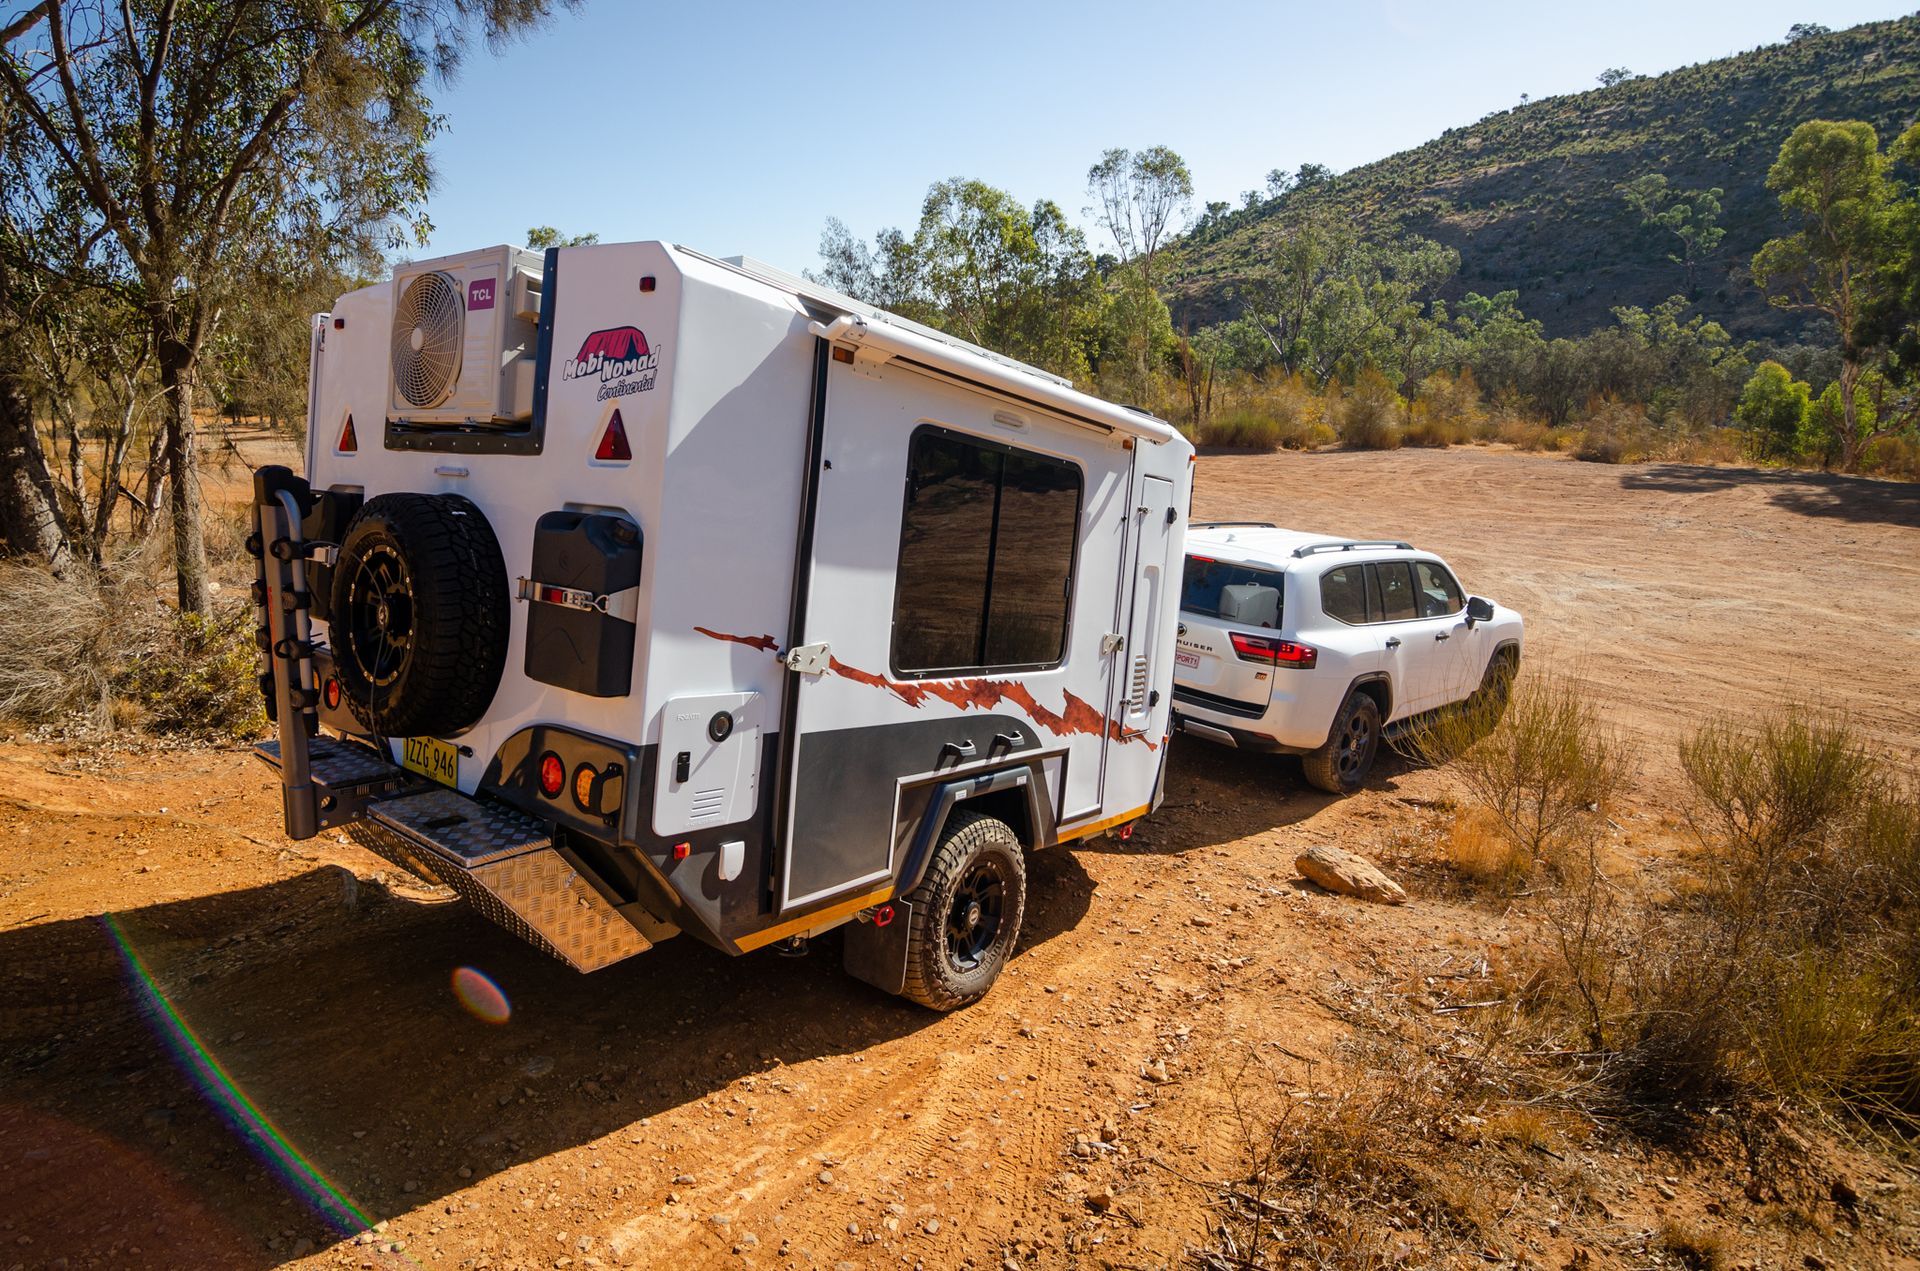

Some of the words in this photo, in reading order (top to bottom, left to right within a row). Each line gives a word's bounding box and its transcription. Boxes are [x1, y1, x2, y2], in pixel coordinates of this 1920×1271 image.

[472, 288, 492, 302] TCL
[562, 350, 604, 381] Mobi
[597, 368, 657, 402] Continental
[1176, 638, 1213, 652] RUISER
[405, 737, 429, 769] 1ZZG
[433, 747, 454, 779] 946
